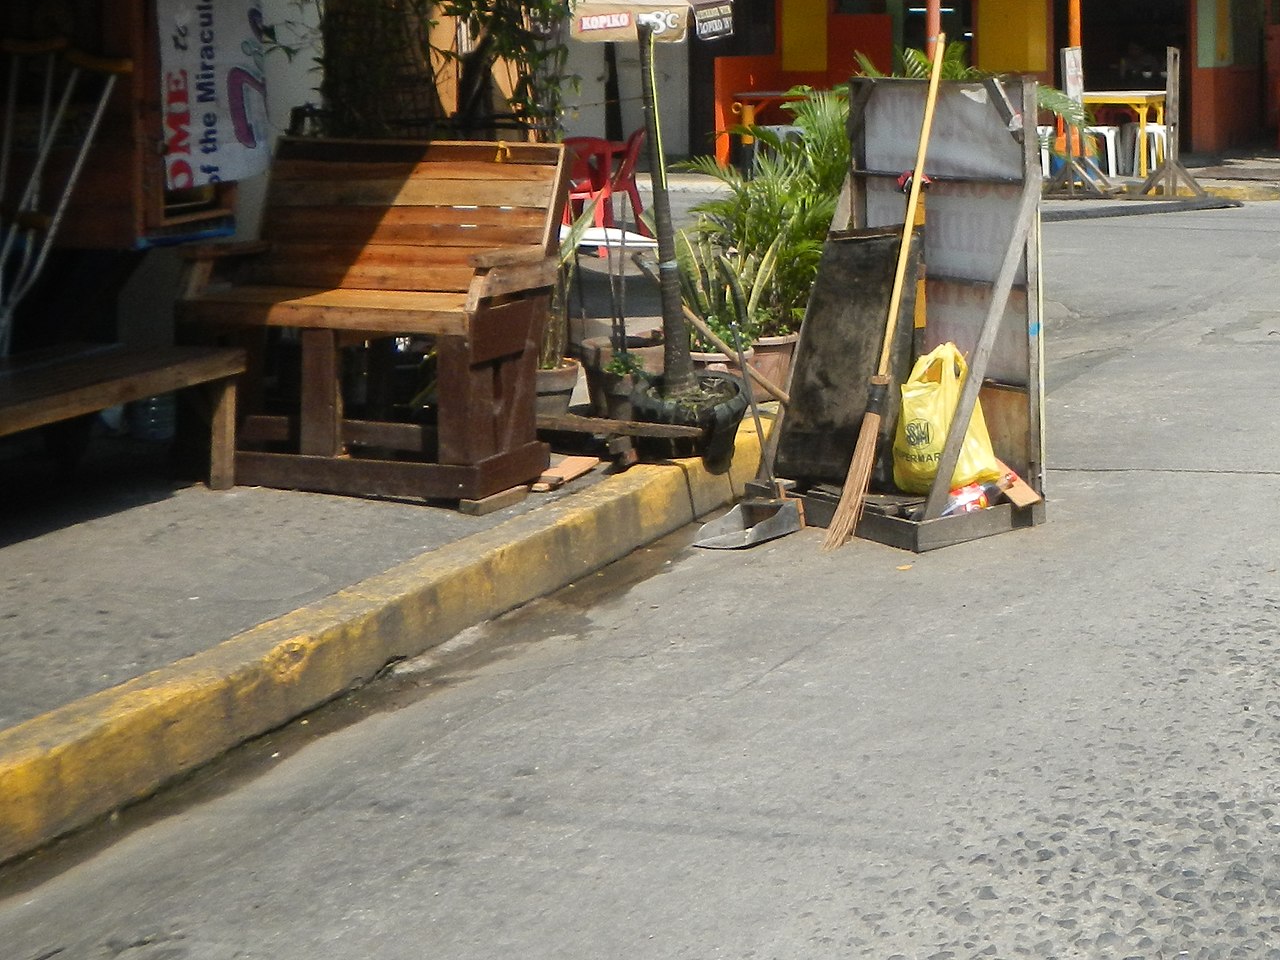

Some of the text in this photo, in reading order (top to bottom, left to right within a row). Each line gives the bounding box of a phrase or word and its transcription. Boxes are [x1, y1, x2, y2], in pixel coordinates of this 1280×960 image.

[581, 13, 630, 31] KOPIKO
[199, 111, 218, 155] the
[905, 421, 931, 446] SM
